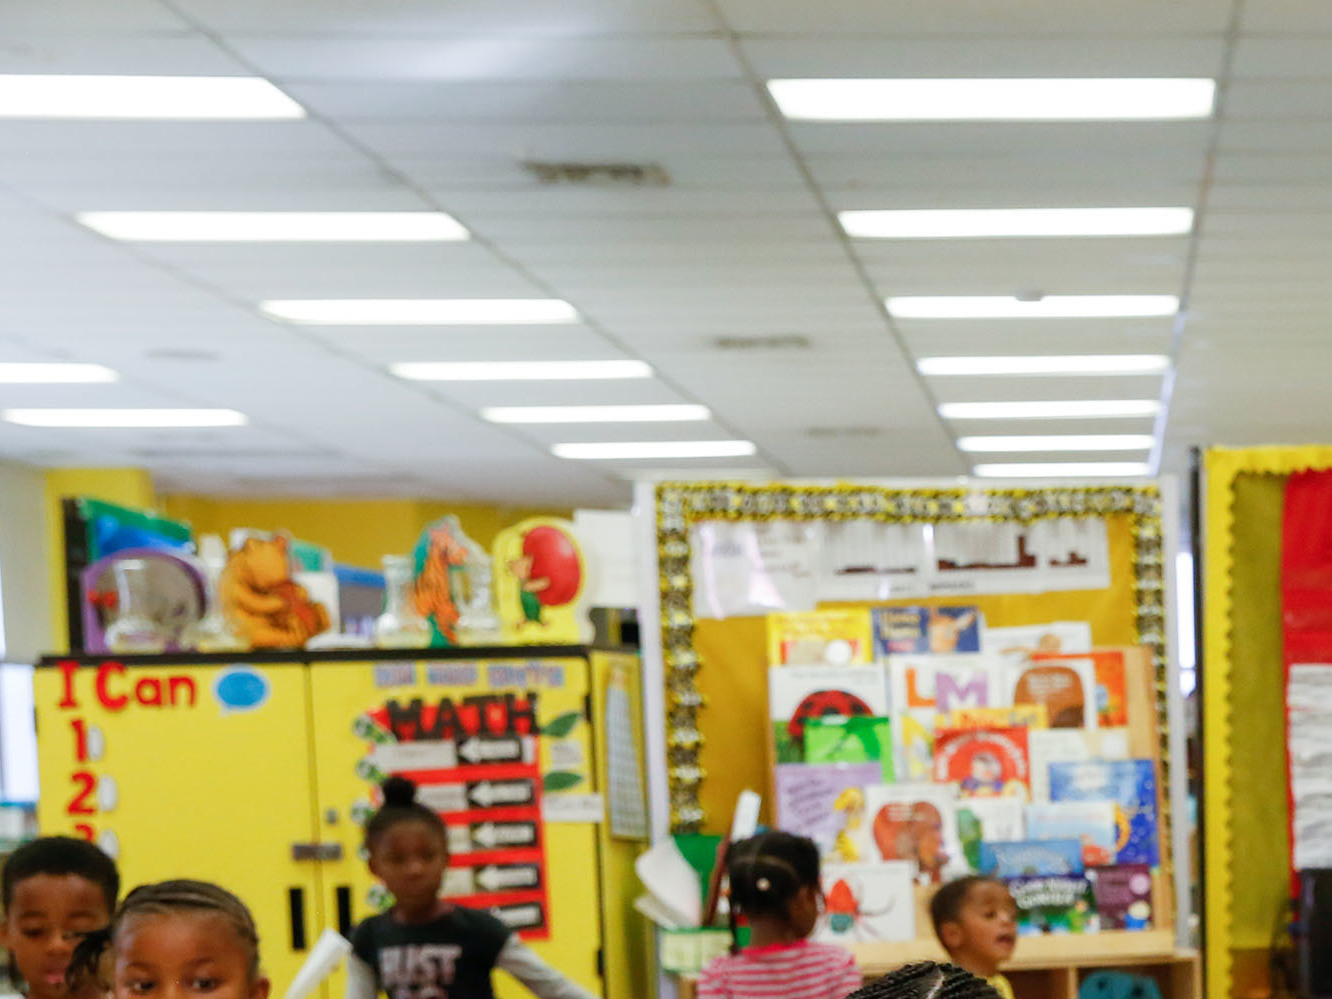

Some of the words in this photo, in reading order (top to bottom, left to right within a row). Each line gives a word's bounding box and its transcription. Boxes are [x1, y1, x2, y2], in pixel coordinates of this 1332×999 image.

[57, 660, 80, 709] I
[96, 661, 196, 711] Can
[386, 693, 540, 741] MATH
[72, 719, 88, 762] 1
[67, 771, 96, 815] 2
